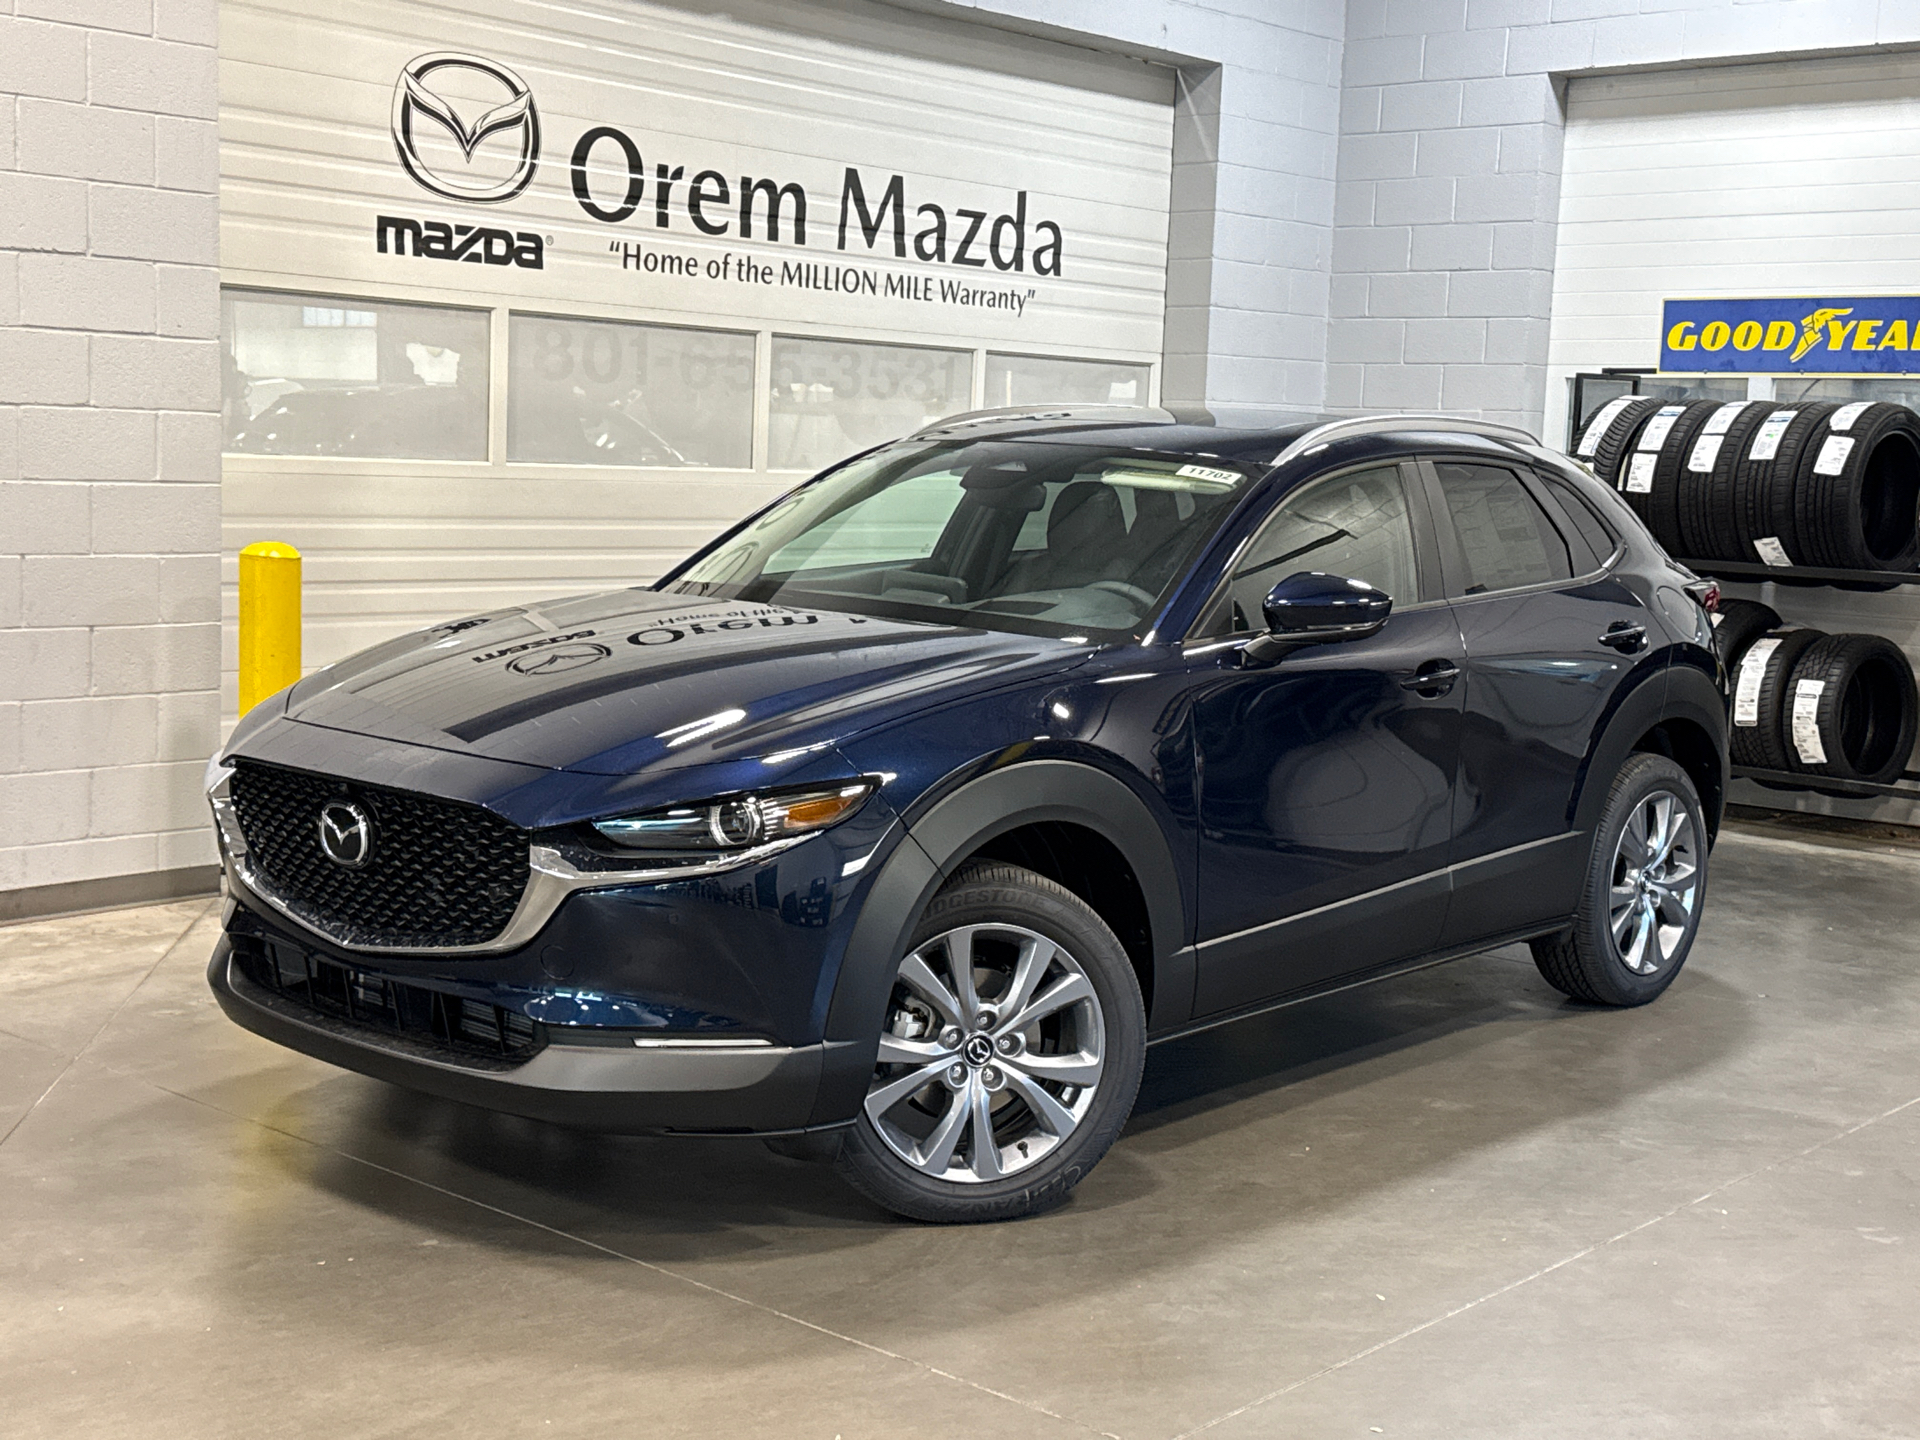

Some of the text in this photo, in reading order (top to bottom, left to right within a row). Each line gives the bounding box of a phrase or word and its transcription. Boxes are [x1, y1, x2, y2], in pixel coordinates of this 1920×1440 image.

[570, 126, 1063, 277] Orem Mazda
[376, 215, 544, 271] mazda
[609, 241, 699, 277] “Home
[706, 252, 733, 281] of
[736, 255, 774, 285] the
[780, 260, 878, 296] MILLION
[884, 272, 934, 302] MILE
